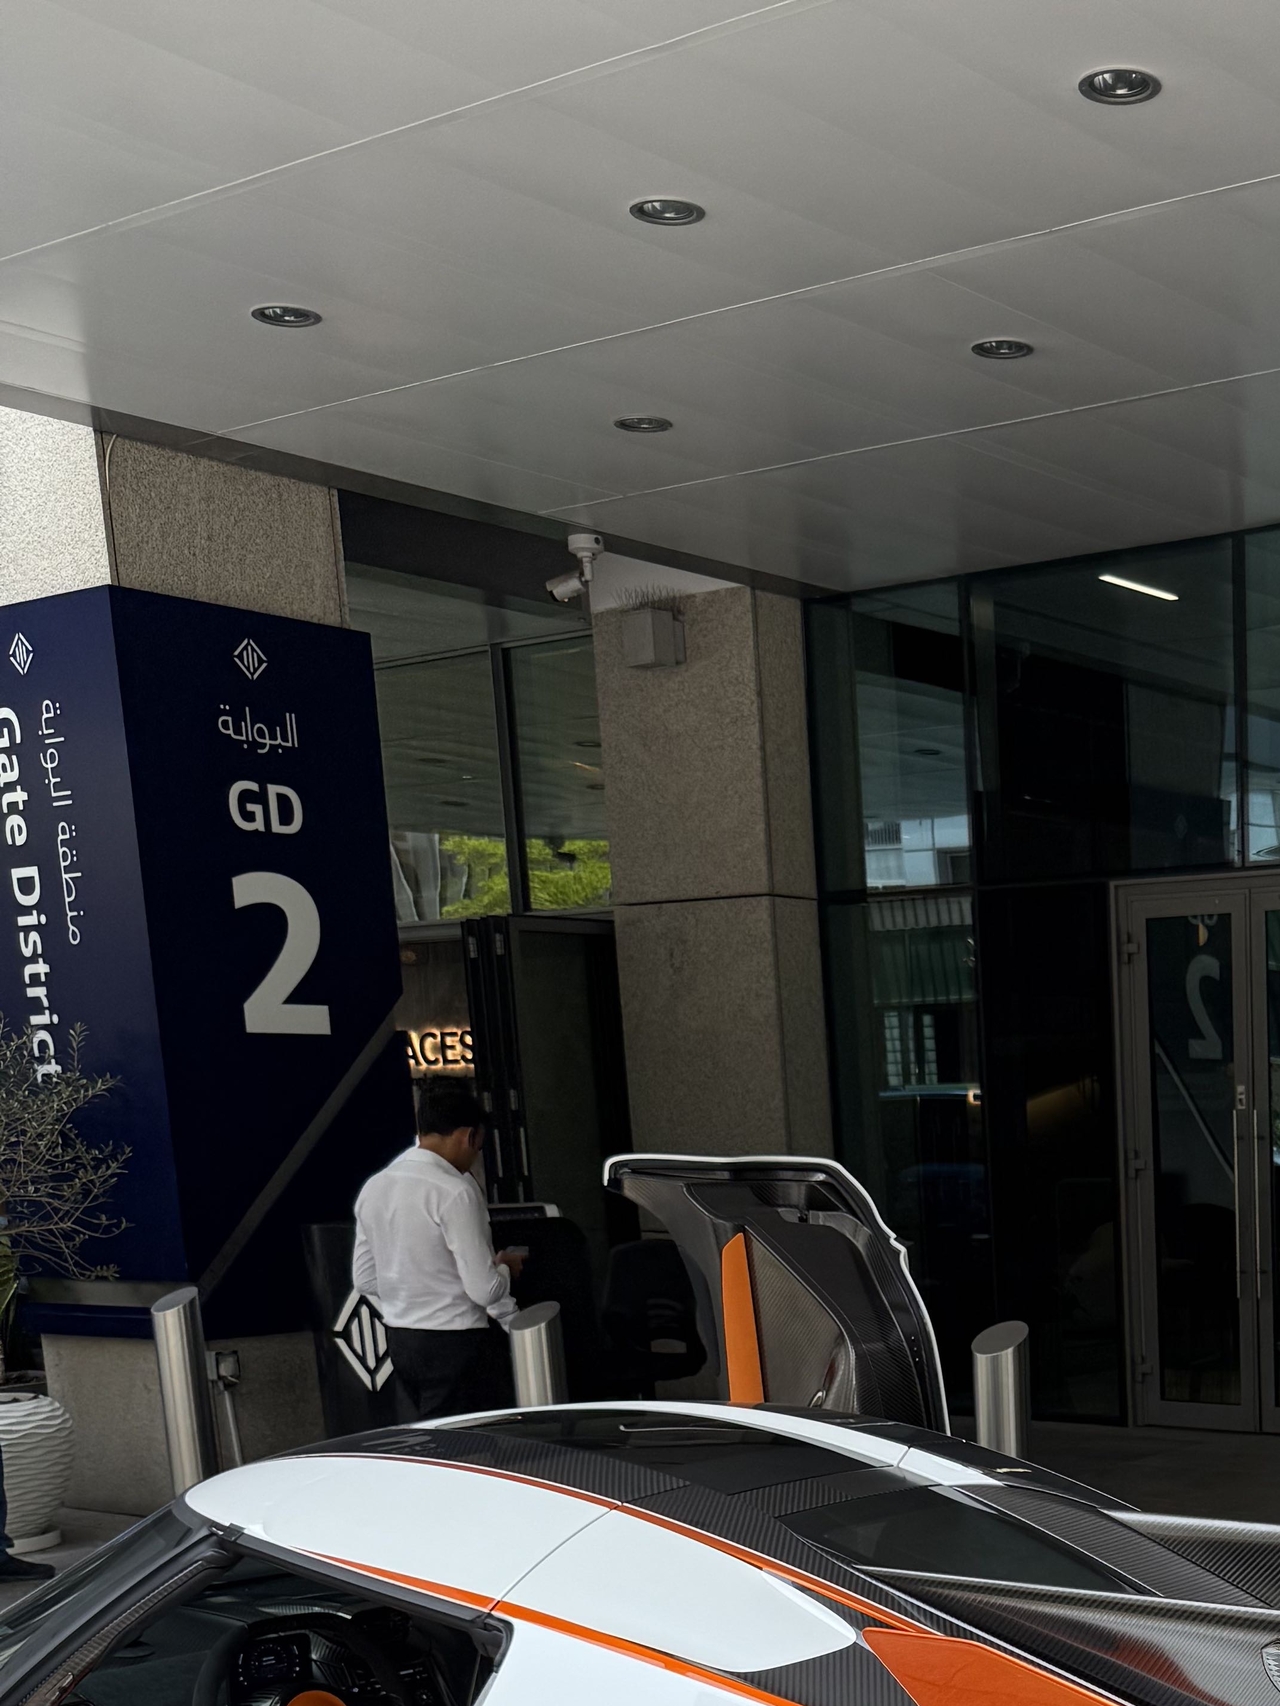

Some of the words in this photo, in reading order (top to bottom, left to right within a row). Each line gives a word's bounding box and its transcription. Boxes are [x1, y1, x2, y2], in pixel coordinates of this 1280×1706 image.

[0, 707, 29, 847] Gate
[38, 699, 73, 807] البوابة
[218, 704, 298, 754] البوابة
[228, 780, 303, 834] GD
[57, 821, 83, 945] منطقة
[11, 865, 63, 1084] District
[231, 871, 331, 1035] 2
